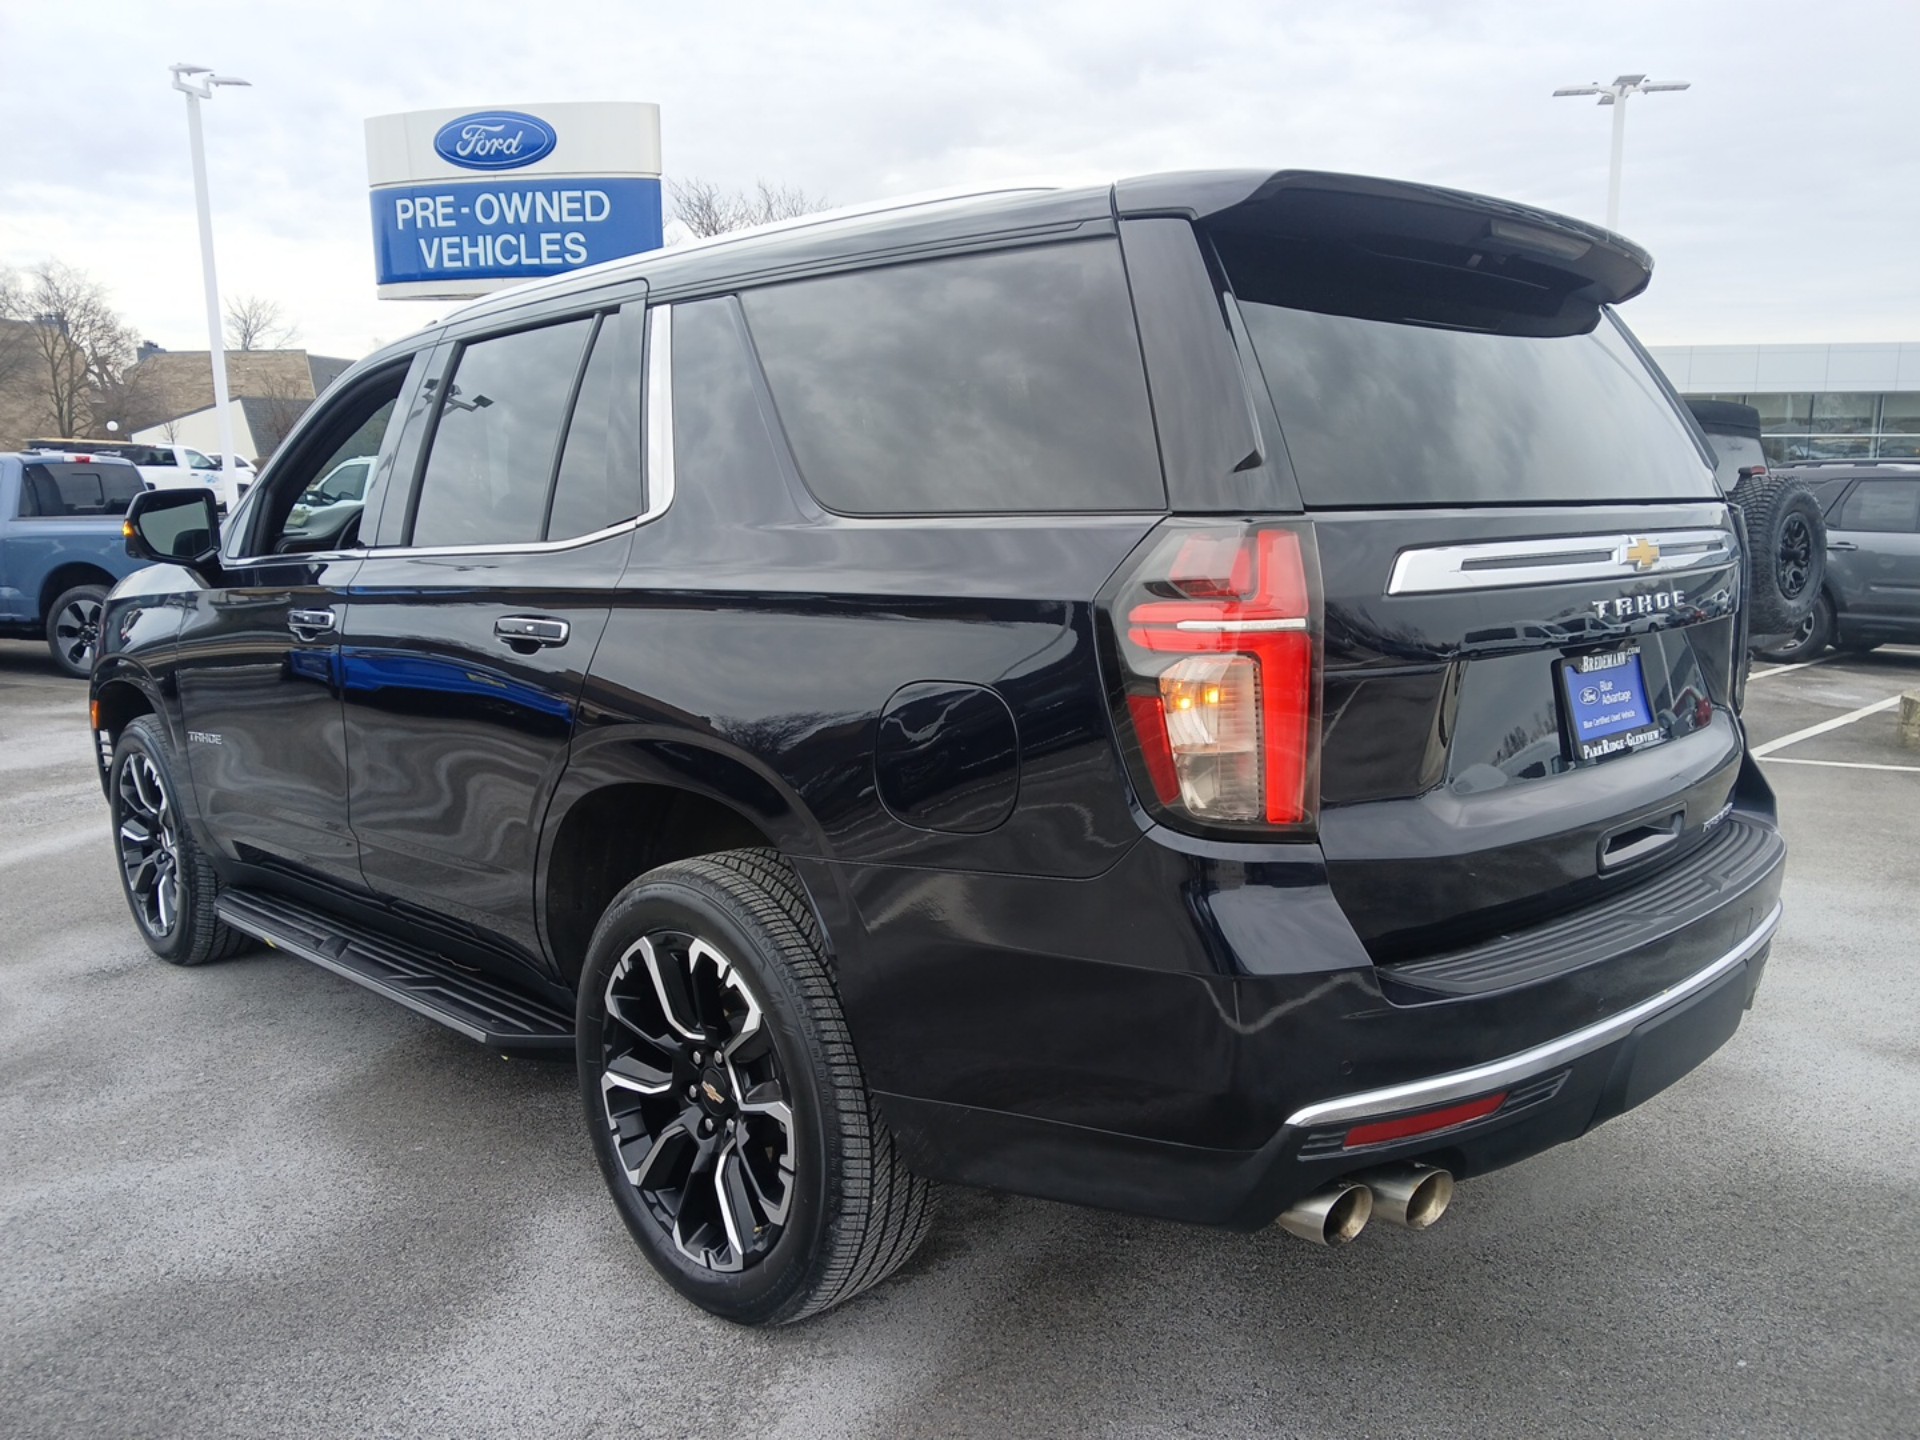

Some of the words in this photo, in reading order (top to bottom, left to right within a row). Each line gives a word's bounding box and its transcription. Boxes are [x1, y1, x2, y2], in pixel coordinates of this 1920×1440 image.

[455, 124, 524, 156] Ford
[395, 190, 612, 230] PRE-OWNED
[418, 232, 588, 269] VEHICLES
[1592, 590, 1686, 619] TAHOE
[187, 731, 223, 745] TAHOE
